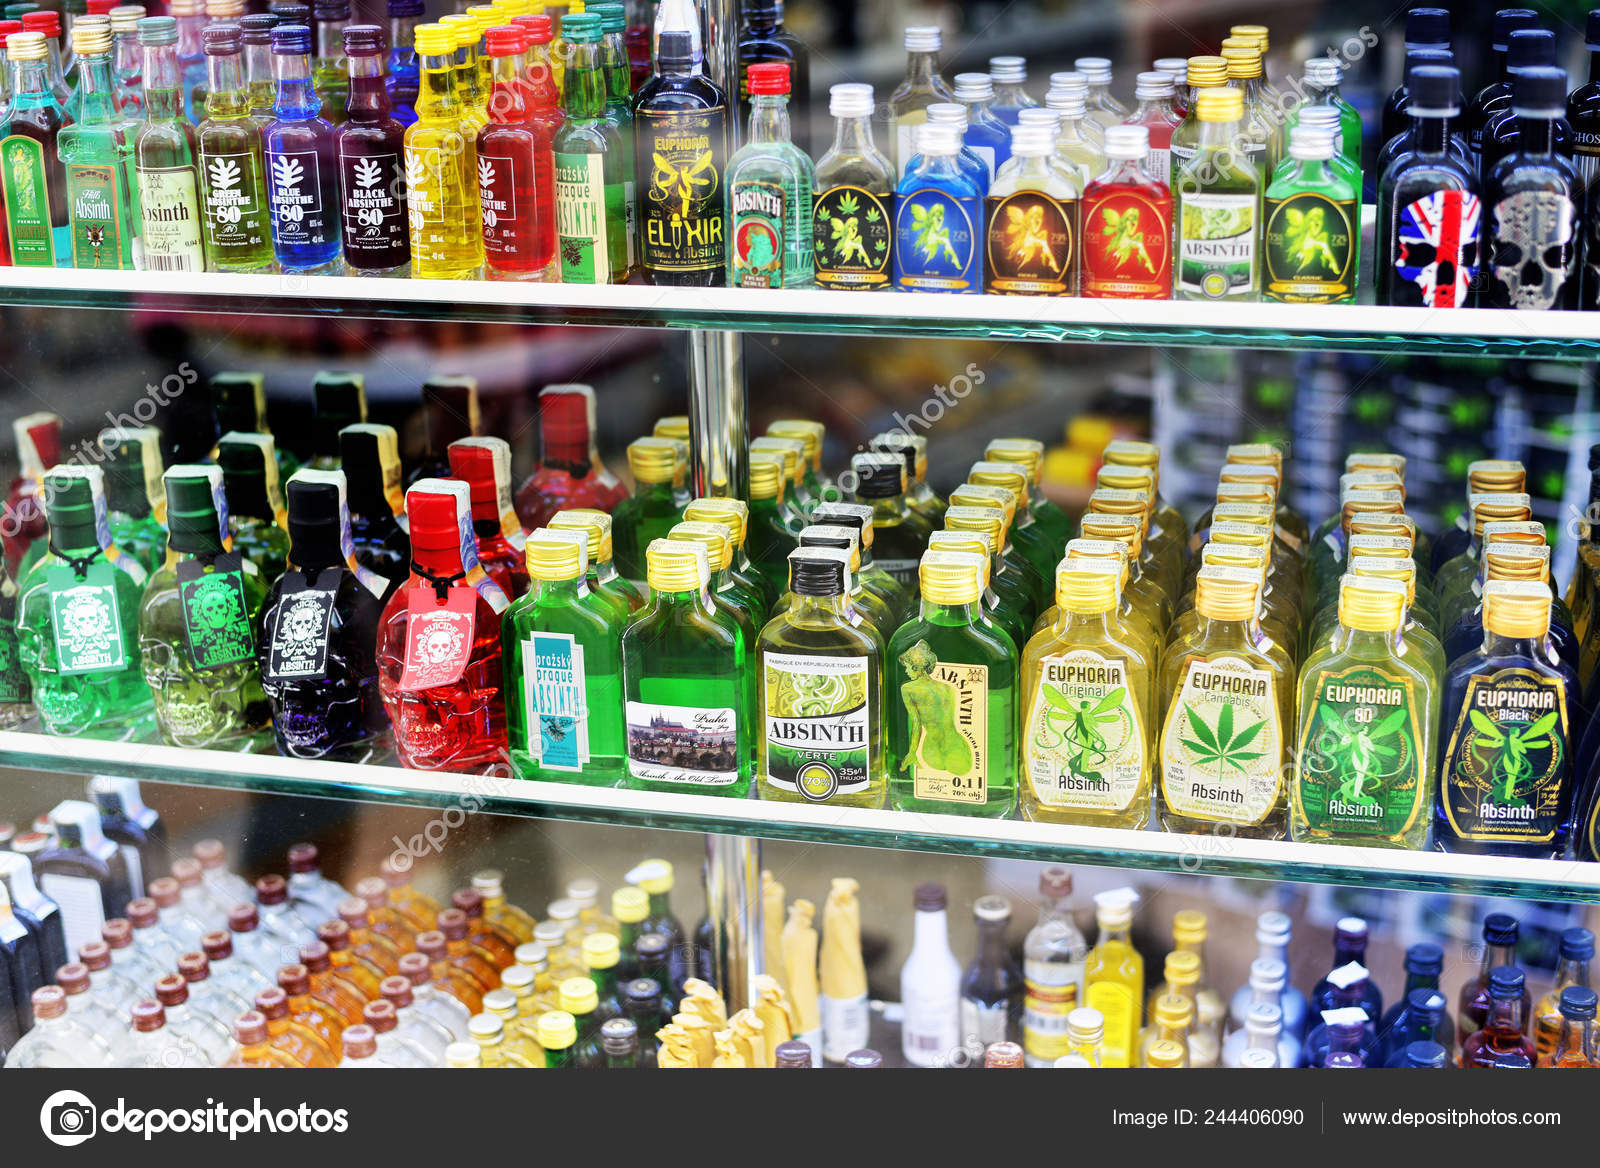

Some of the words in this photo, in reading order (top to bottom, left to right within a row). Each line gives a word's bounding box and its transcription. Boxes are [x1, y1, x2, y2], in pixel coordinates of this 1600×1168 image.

[655, 136, 710, 150] EUPHORIA
[272, 195, 314, 205] ABSINTHE
[278, 188, 301, 196] BLUE
[352, 188, 385, 198] BLACK
[76, 198, 112, 220] Absinth
[207, 196, 251, 206] ABSINTHE
[348, 197, 393, 208] ABSINTHE
[735, 190, 782, 217] ABSINTH
[216, 206, 242, 223] 80
[280, 204, 304, 222] 80
[358, 208, 384, 226] 80
[1183, 243, 1250, 257] ABSINTH
[423, 622, 459, 634] SUICIDE
[72, 652, 112, 665] ABSINTH
[279, 660, 316, 672] ABSINTH
[536, 652, 573, 670] pražský
[536, 669, 573, 685] prague
[1048, 665, 1121, 685] EUPHORIA
[1061, 683, 1106, 699] Original
[1192, 671, 1268, 697] EUPHORIA
[532, 683, 580, 716] ABSINTH
[1203, 691, 1250, 707] Cannabis
[1326, 685, 1403, 706] EUPHORIA
[1476, 690, 1555, 709] EUPHORIA
[692, 710, 728, 723] Praha
[1353, 707, 1373, 723] 80
[1498, 709, 1529, 721] Black
[769, 721, 865, 743] ABSINTH
[797, 751, 837, 761] VERTE
[803, 776, 831, 787] 70%
[1059, 774, 1111, 792] Absinth
[1191, 783, 1245, 804] Absinth
[1328, 799, 1385, 817] Absinth
[1479, 803, 1536, 820] Absinth
